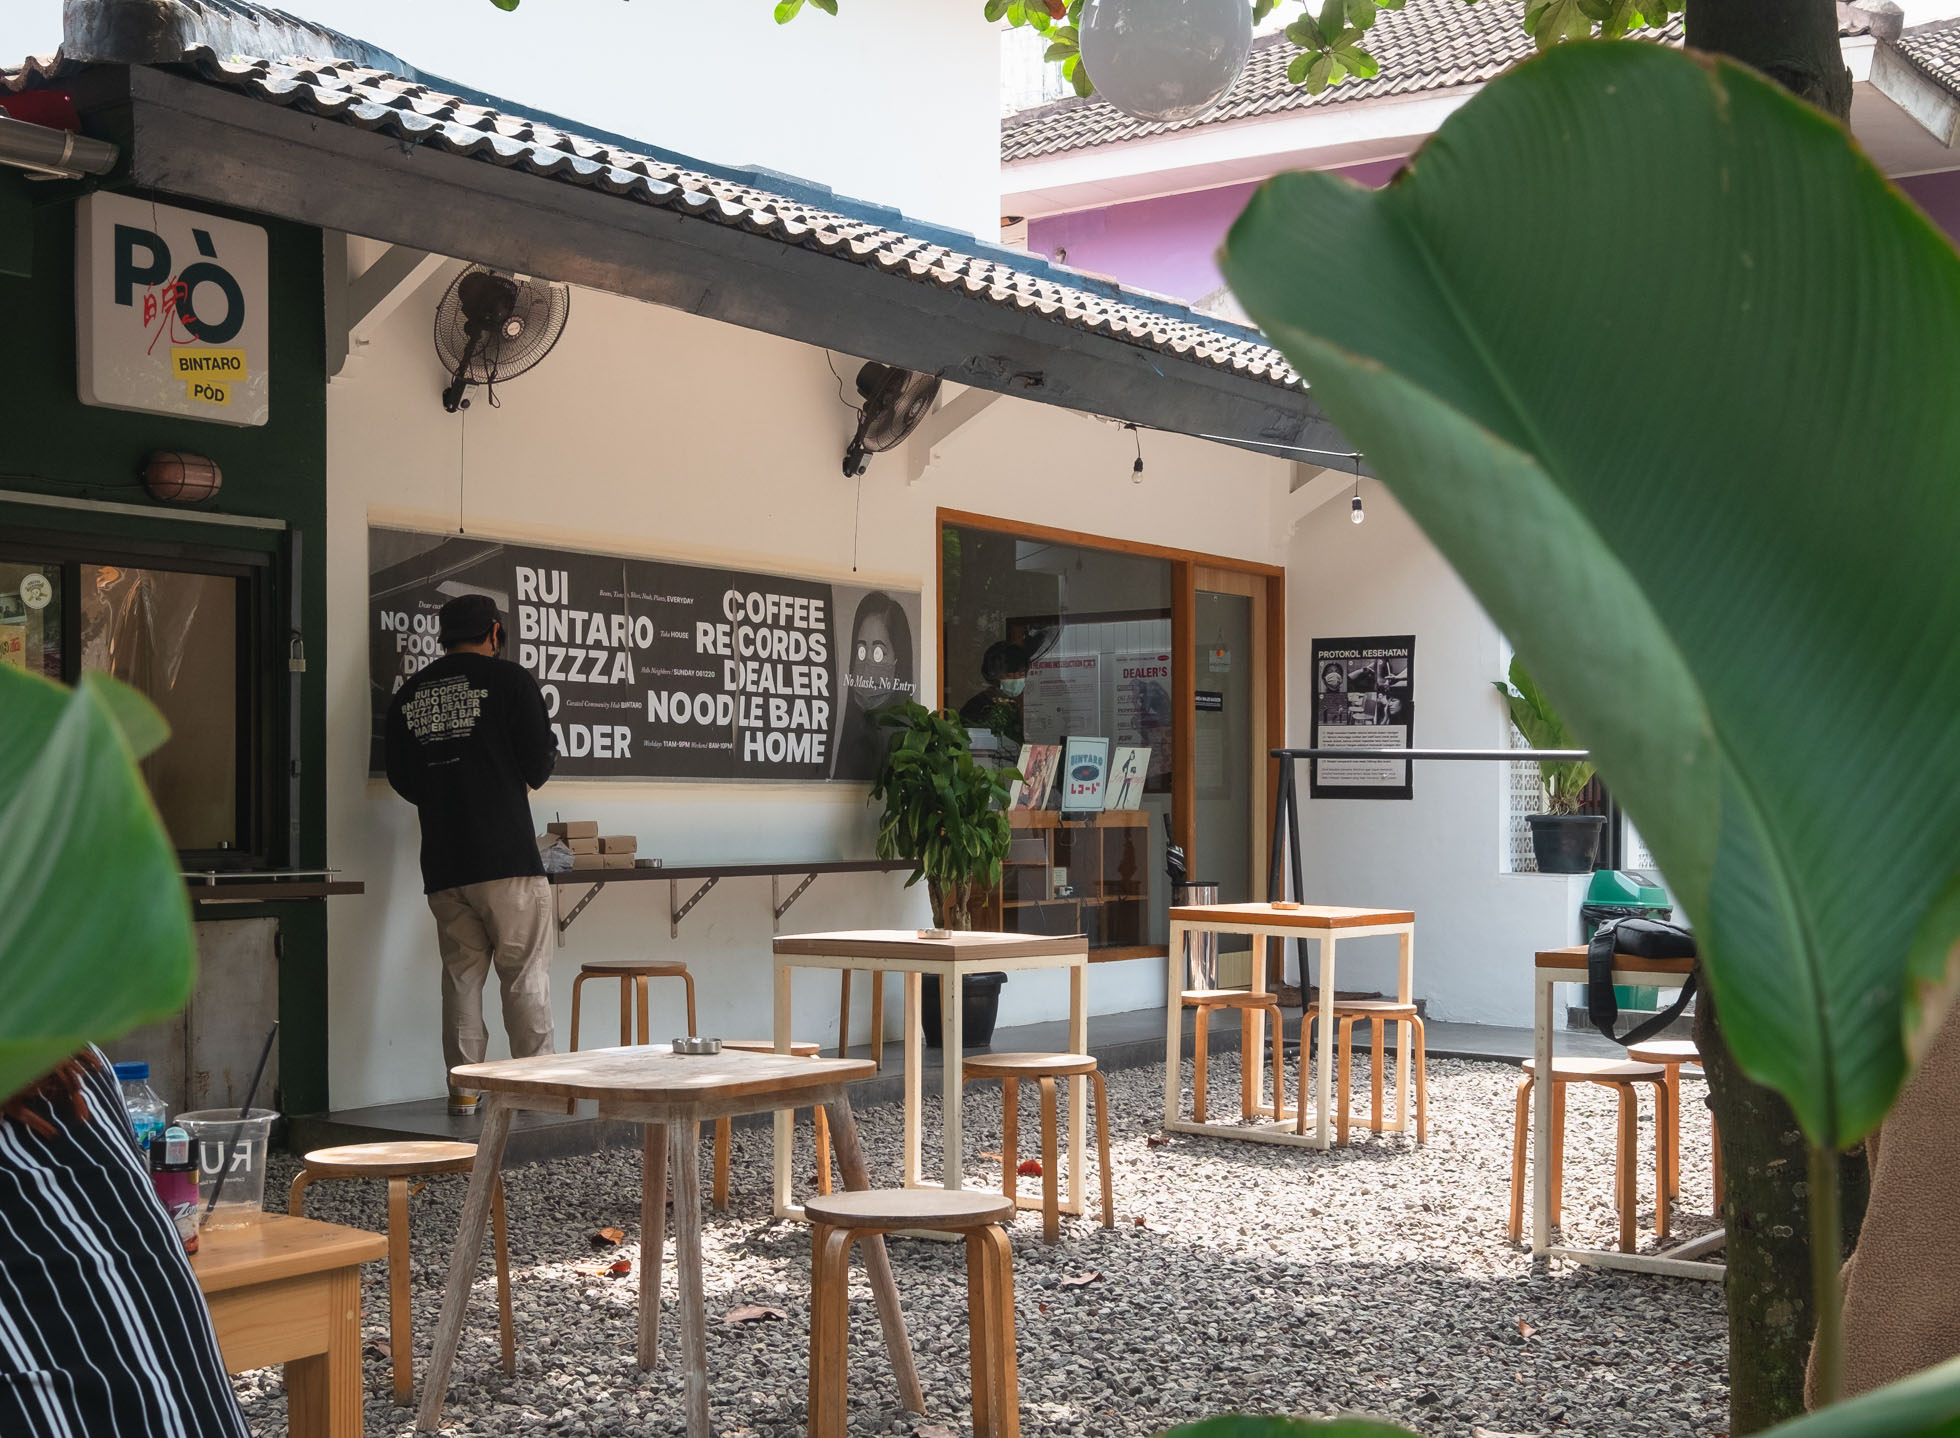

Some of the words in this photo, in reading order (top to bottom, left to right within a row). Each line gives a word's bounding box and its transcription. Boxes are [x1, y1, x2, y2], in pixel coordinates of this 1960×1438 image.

[115, 223, 244, 344] PÒ
[179, 357, 240, 371] BINTARO
[194, 384, 225, 402] PÒD
[516, 566, 568, 605] RUI
[667, 596, 694, 604] EVERYDAY
[723, 589, 825, 630] COFFEE
[381, 610, 410, 632] NO
[413, 613, 440, 635] OU
[518, 605, 654, 649] BINTARO
[670, 631, 689, 639] HOUSE
[696, 621, 827, 663] RECORDS
[519, 643, 635, 685] PIZZZA
[1318, 650, 1361, 659] PROTOKOL
[1362, 648, 1408, 658] KESEHATAN
[673, 668, 695, 677] SUNDAY
[724, 659, 830, 697] DEALER
[843, 673, 853, 686] No
[854, 675, 877, 690] Mask,
[878, 677, 892, 689] No
[892, 678, 917, 696] Entry
[1123, 667, 1168, 679] DEALER'S
[401, 696, 440, 714] BNTARO
[441, 689, 488, 704] RECORDS
[415, 688, 431, 700] RUI
[431, 682, 470, 697] COFFEE
[540, 684, 560, 719] O
[442, 698, 480, 712] DEALER
[458, 707, 481, 718] BAR
[648, 690, 763, 728] NOODLE
[769, 697, 830, 730] BAR
[446, 717, 476, 730] HOME
[550, 723, 632, 759] ADER
[744, 730, 827, 764] HOME
[1071, 754, 1103, 766] BINTARO
